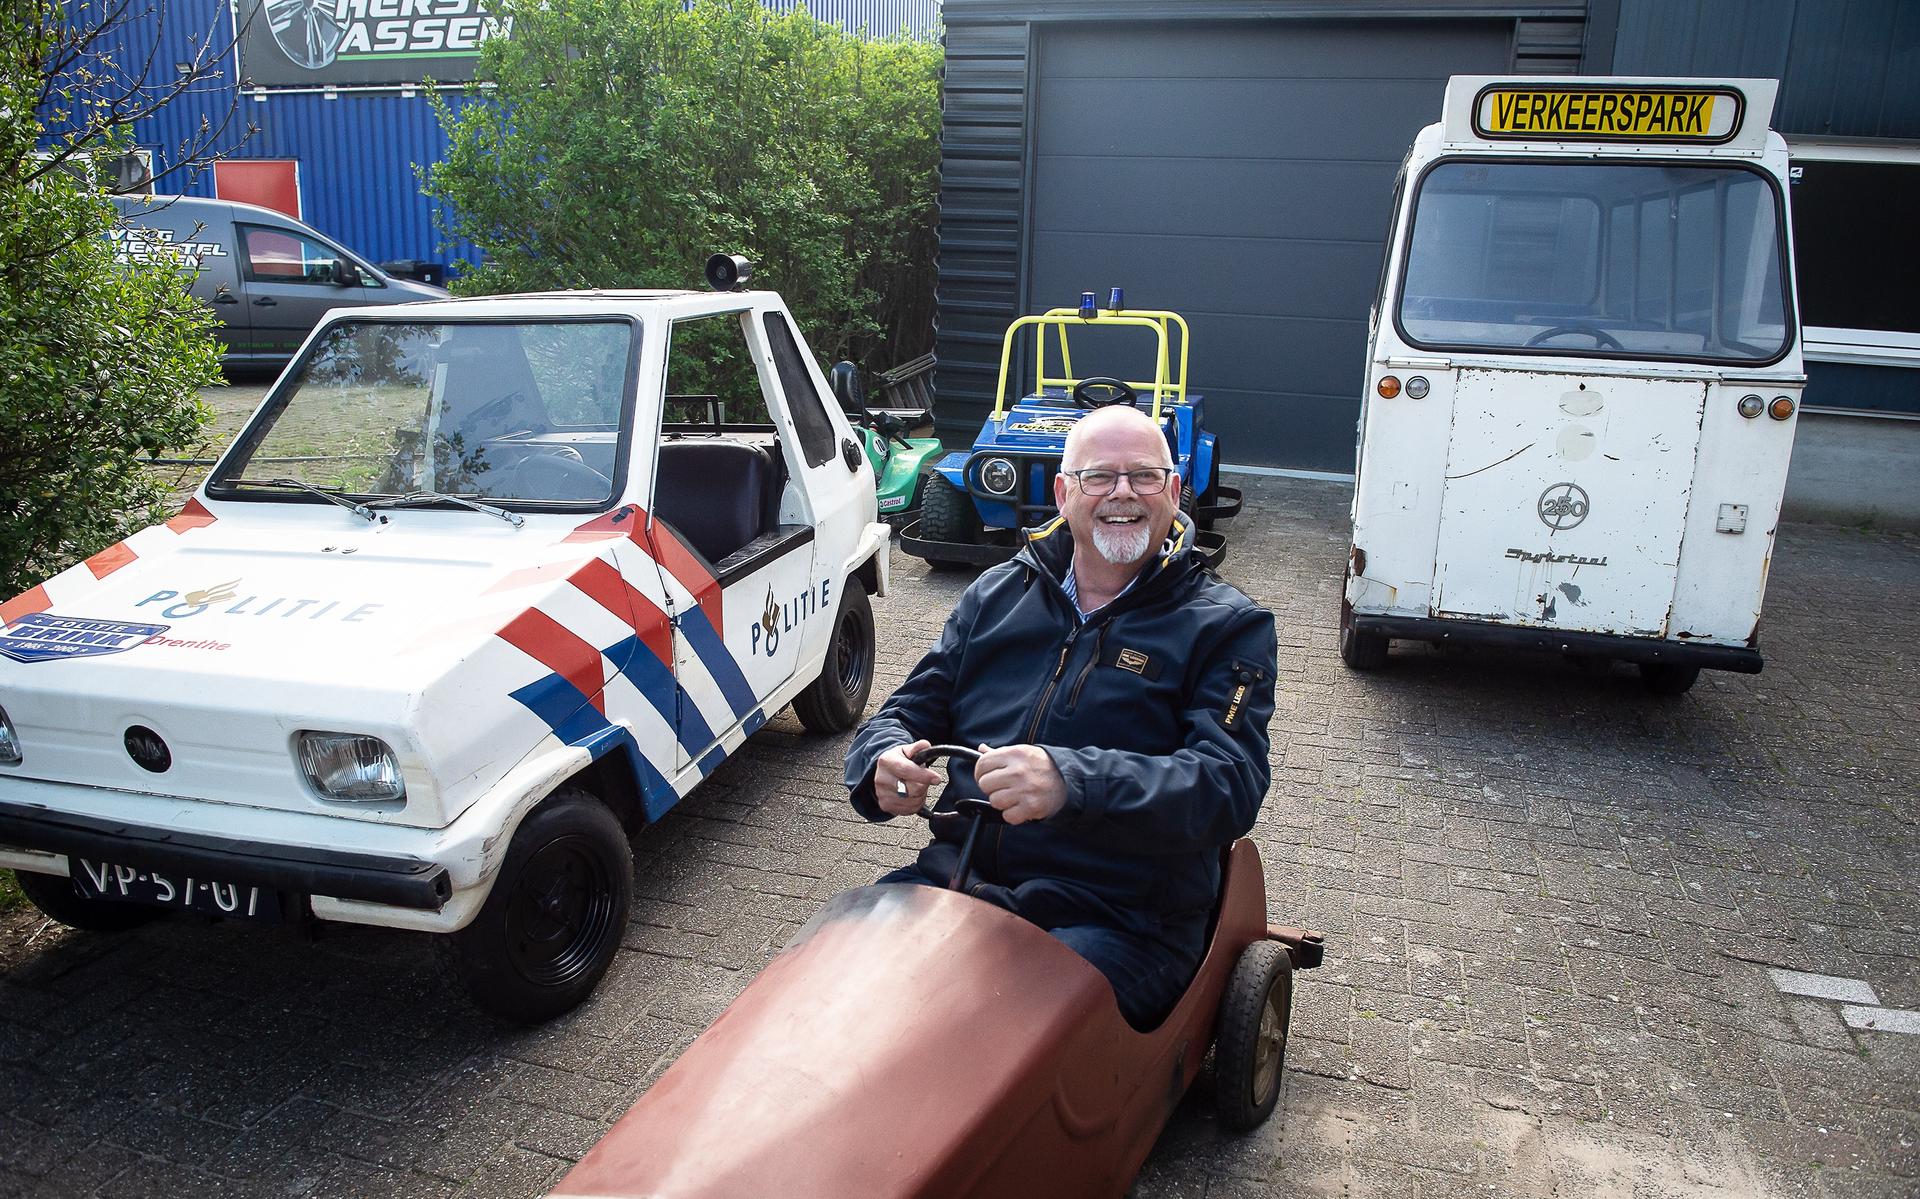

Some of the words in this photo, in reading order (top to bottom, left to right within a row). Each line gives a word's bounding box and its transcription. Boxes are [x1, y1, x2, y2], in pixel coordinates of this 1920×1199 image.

[338, 16, 513, 52] ASSEN
[1498, 94, 1709, 133] VERKEERSPARK
[134, 589, 384, 623] POLITIE
[752, 579, 830, 658] POLITIE
[8, 625, 133, 646] BRINK
[50, 620, 129, 633] POLITIE
[144, 635, 232, 651] Drenthe
[1225, 704, 1238, 725] PME
